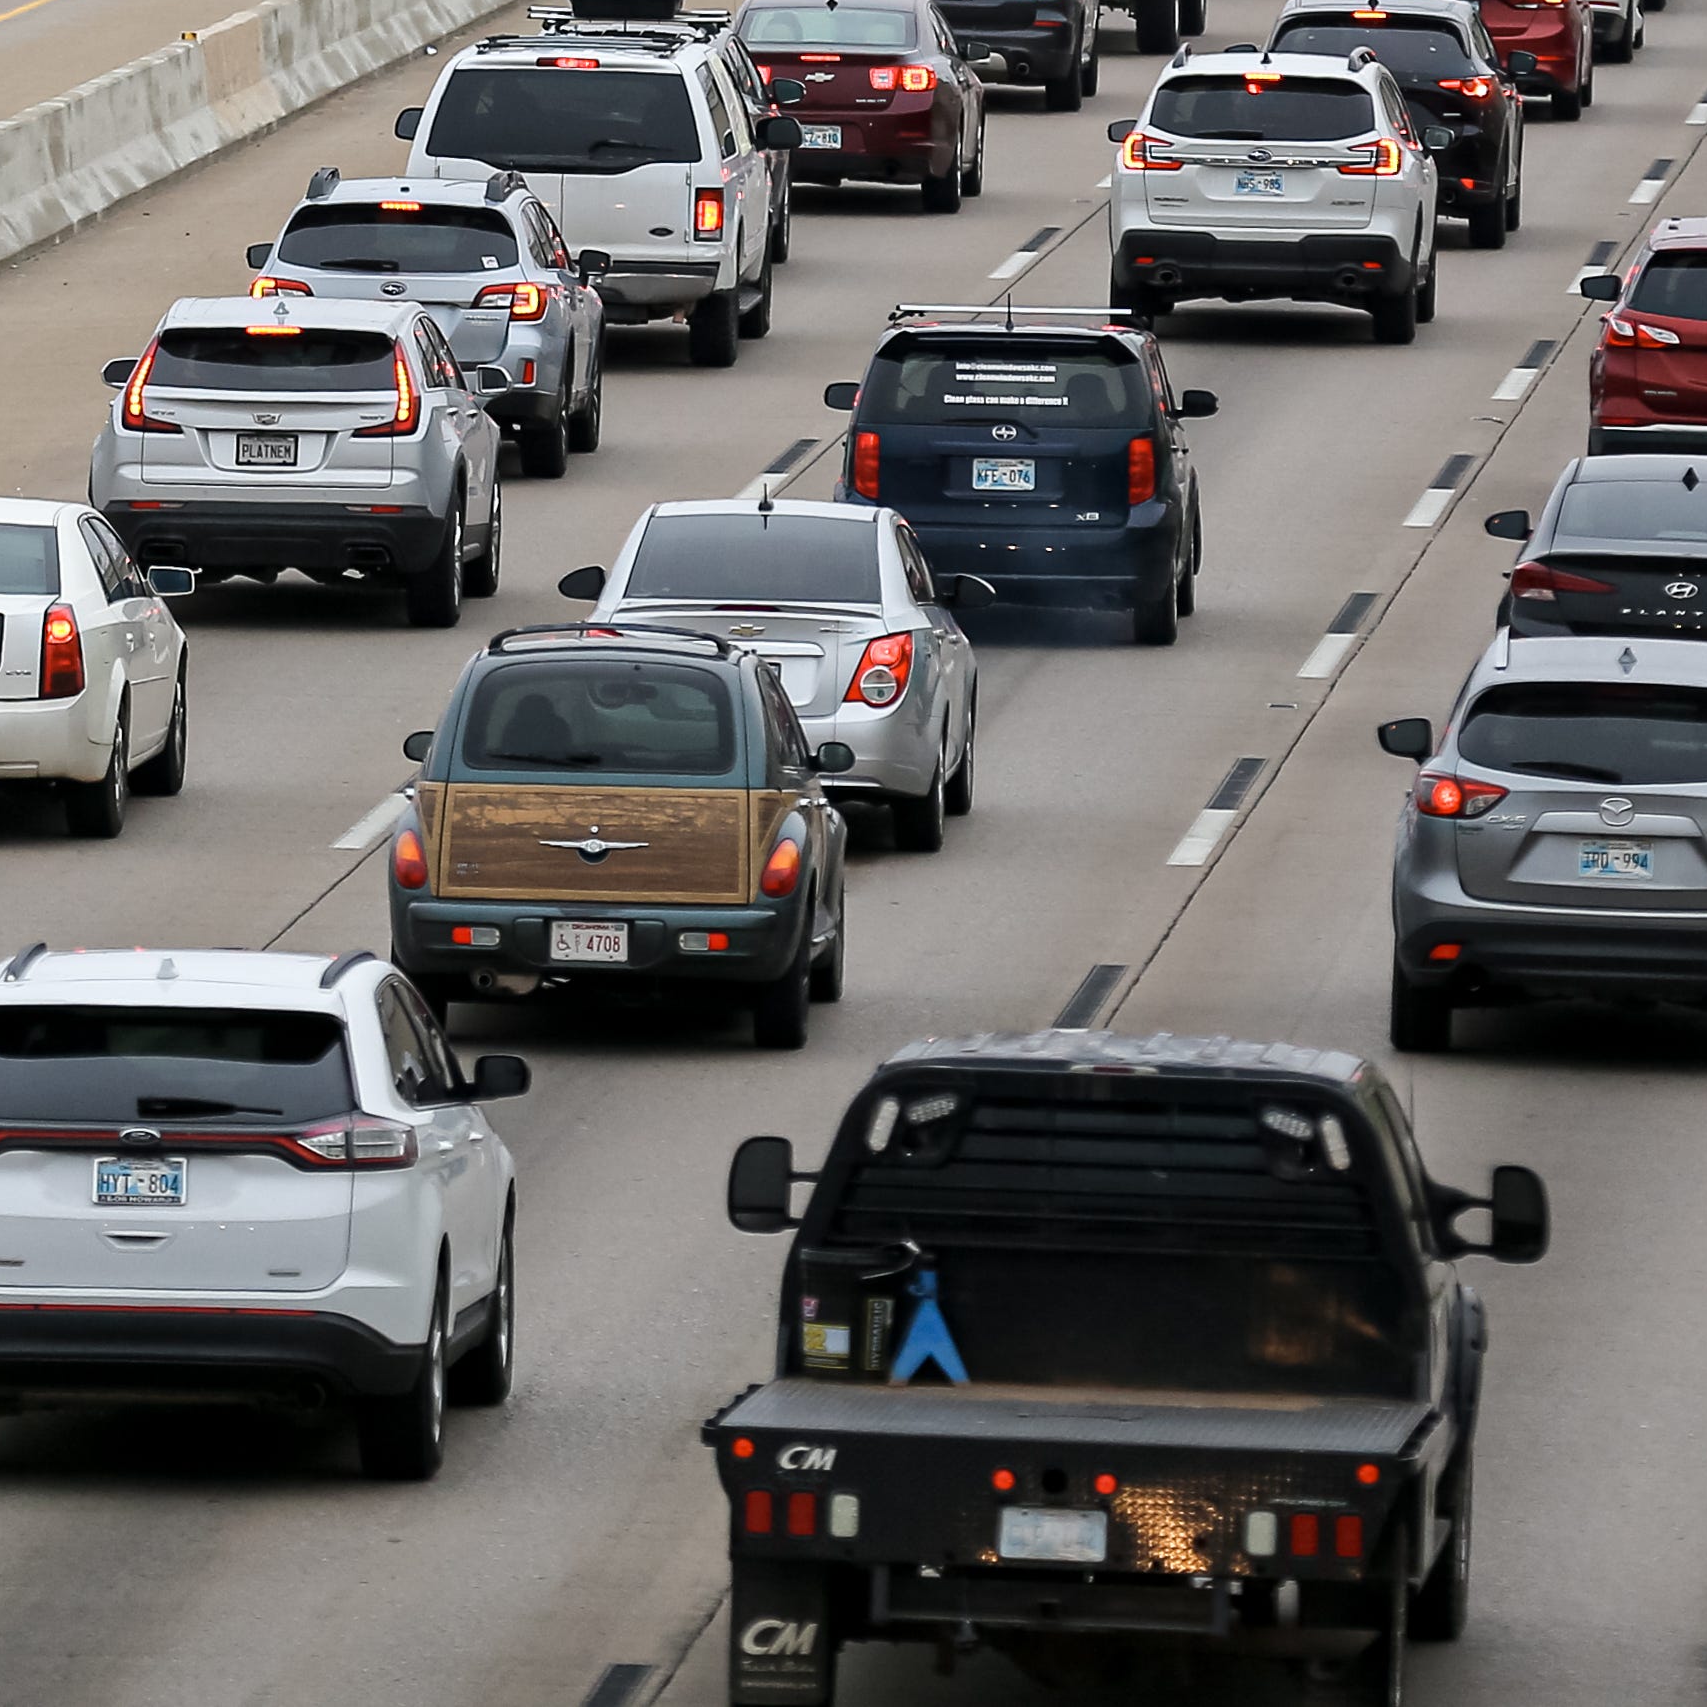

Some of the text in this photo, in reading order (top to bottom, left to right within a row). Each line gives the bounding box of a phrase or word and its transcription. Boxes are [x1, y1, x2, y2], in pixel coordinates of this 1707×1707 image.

[242, 445, 292, 459] PLATNEM
[977, 469, 1031, 483] KFE-076
[586, 936, 620, 952] 4708
[101, 1174, 179, 1194] HYT-804
[780, 1446, 838, 1471] CM
[742, 1620, 818, 1656] CM
